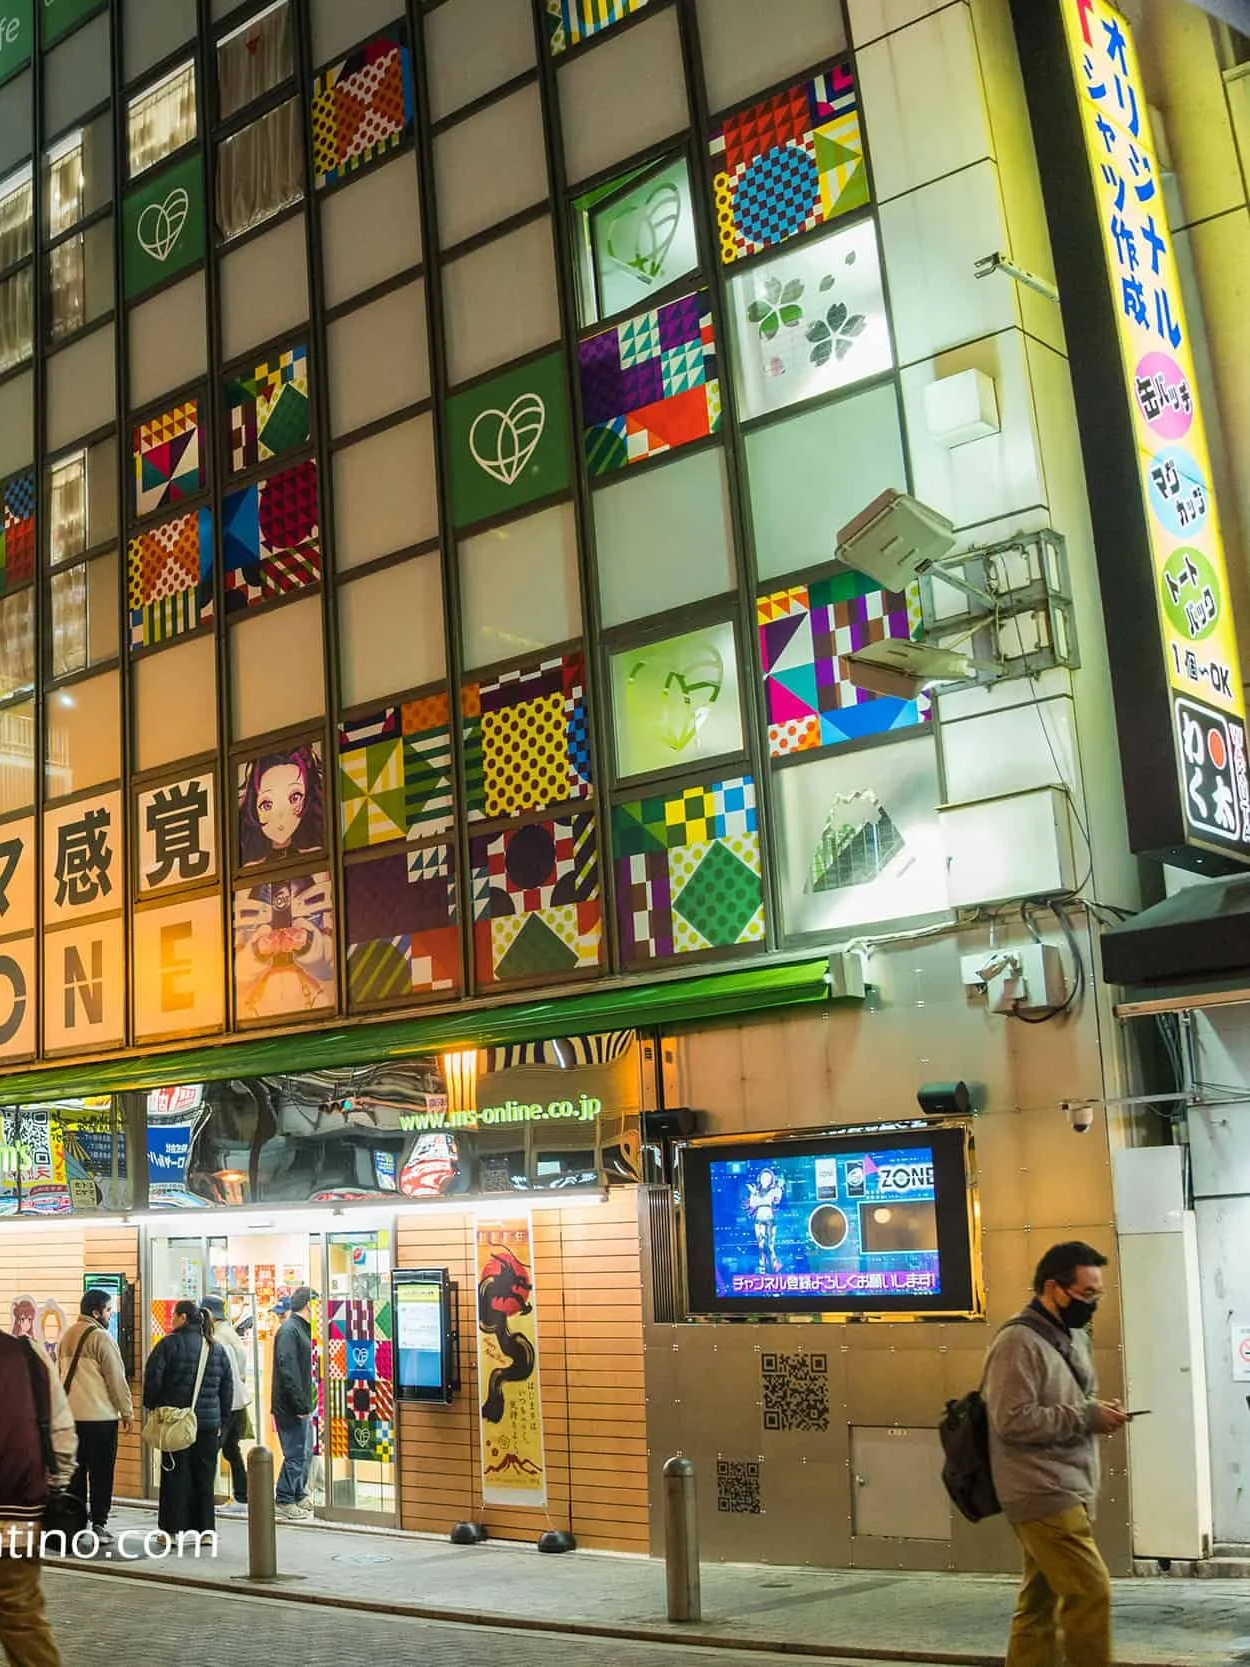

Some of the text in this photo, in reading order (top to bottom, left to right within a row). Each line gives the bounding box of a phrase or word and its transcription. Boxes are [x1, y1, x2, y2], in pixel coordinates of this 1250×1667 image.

[1102, 17, 1181, 350] オリジナル
[1165, 556, 1198, 603] トート
[400, 1093, 601, 1131] www.ms-online.co.jp
[881, 1166, 935, 1188] ZONE
